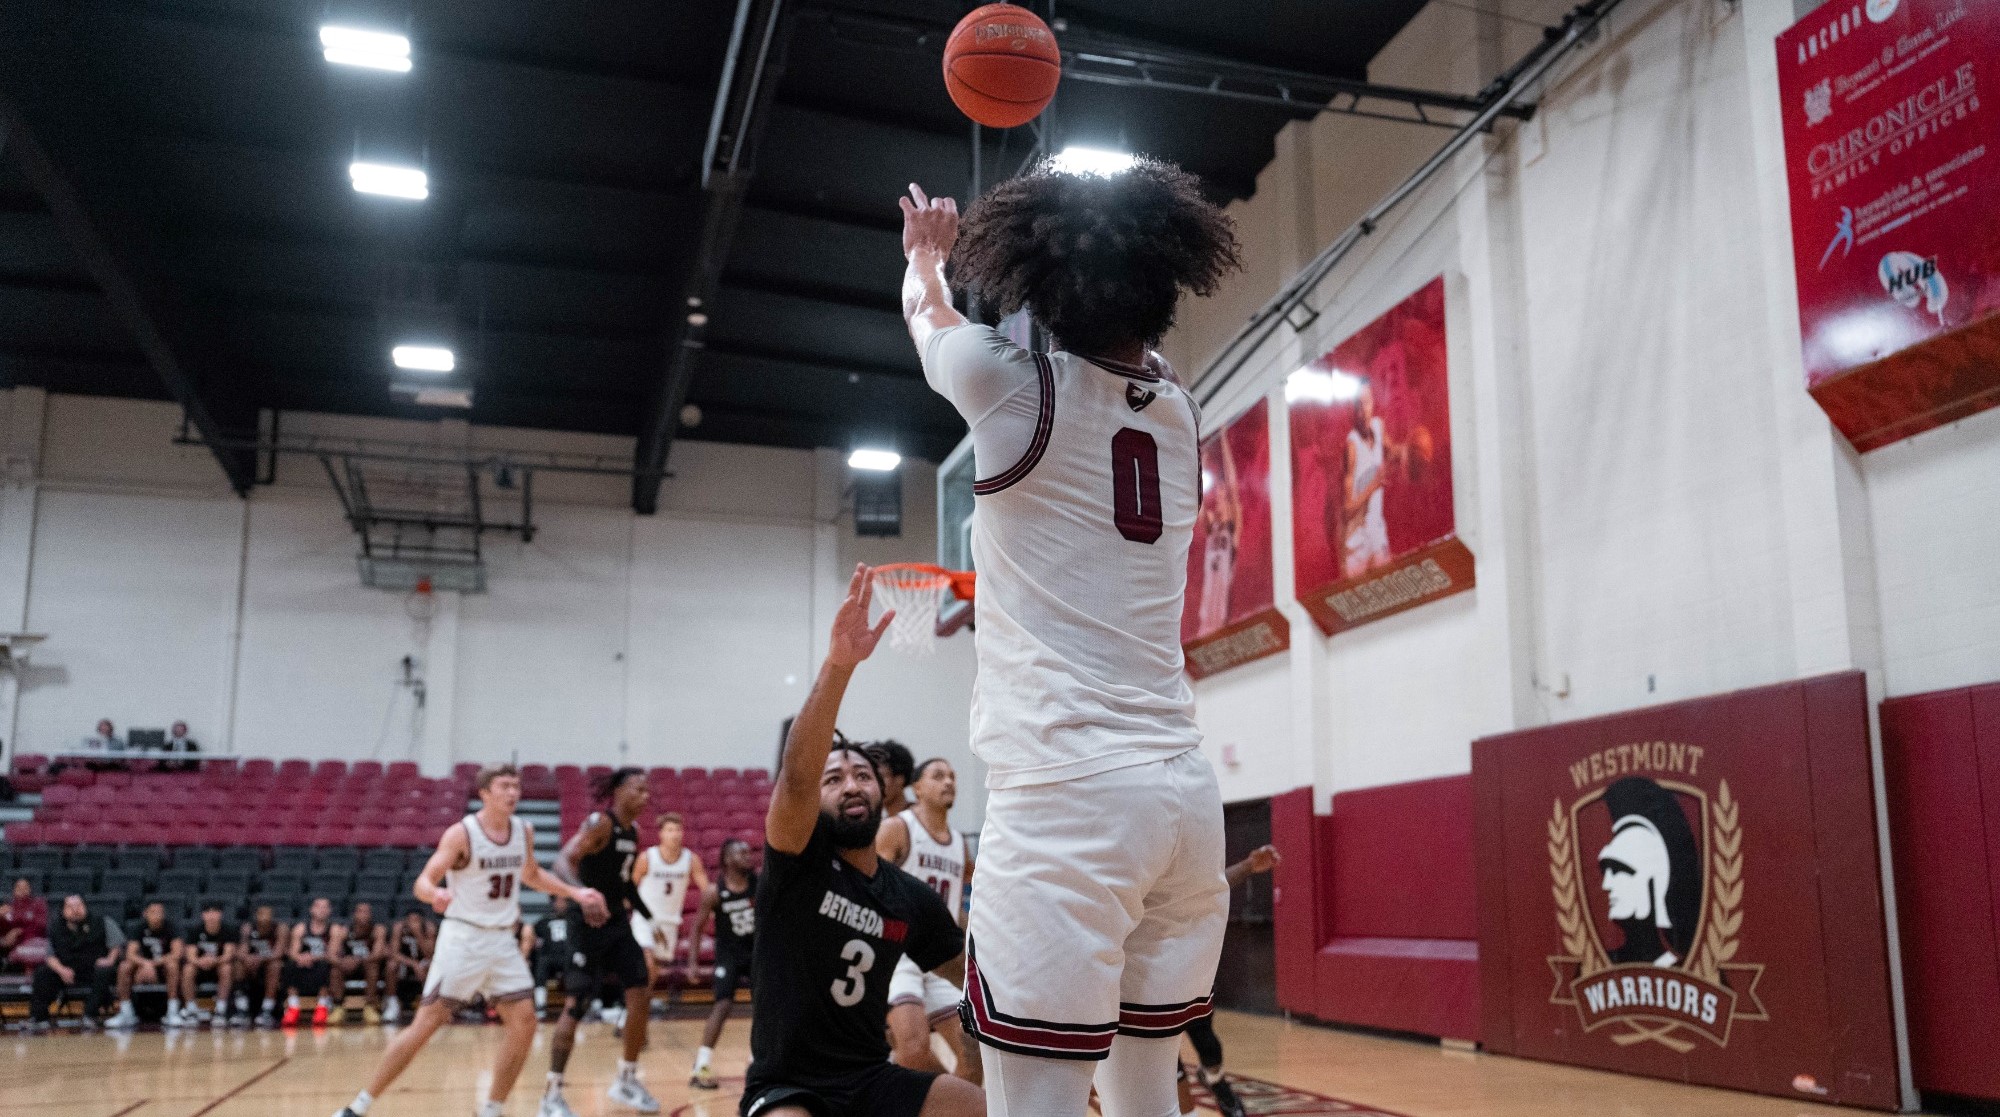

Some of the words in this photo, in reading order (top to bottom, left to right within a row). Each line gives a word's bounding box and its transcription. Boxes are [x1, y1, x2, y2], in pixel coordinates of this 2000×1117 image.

[1807, 61, 1977, 176] CHRONICLE
[1811, 151, 1880, 199] FAMILY
[1890, 95, 1980, 156] OFFICES
[1889, 257, 1936, 294] HUB
[1111, 426, 1164, 545] 0
[1569, 741, 1704, 789] WESTMONT
[830, 928, 876, 1008] 3
[1584, 975, 1719, 1026] WARRIORS
